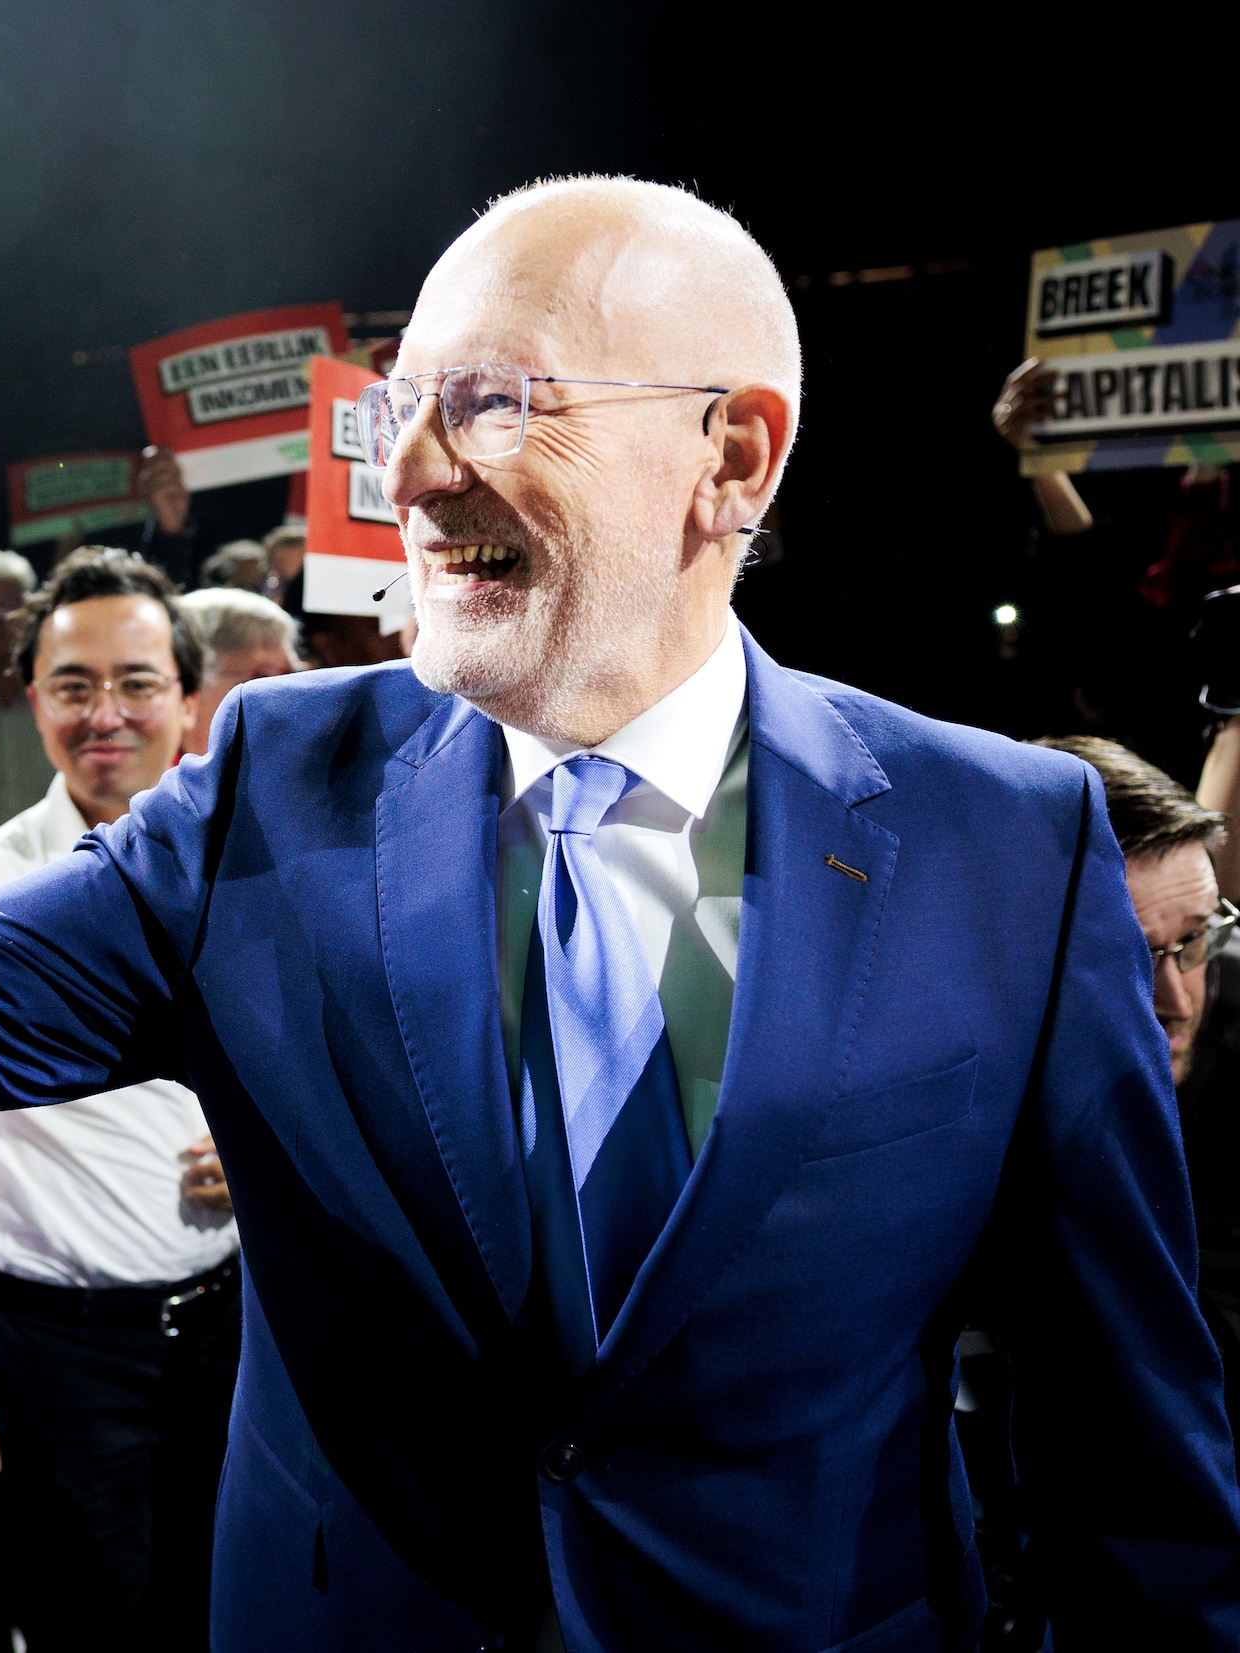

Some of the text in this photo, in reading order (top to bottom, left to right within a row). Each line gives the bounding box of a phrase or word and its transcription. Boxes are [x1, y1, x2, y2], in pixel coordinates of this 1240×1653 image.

[1039, 262, 1151, 321] BREEK
[170, 353, 219, 382] EEN
[1052, 355, 1240, 419] APITALI
